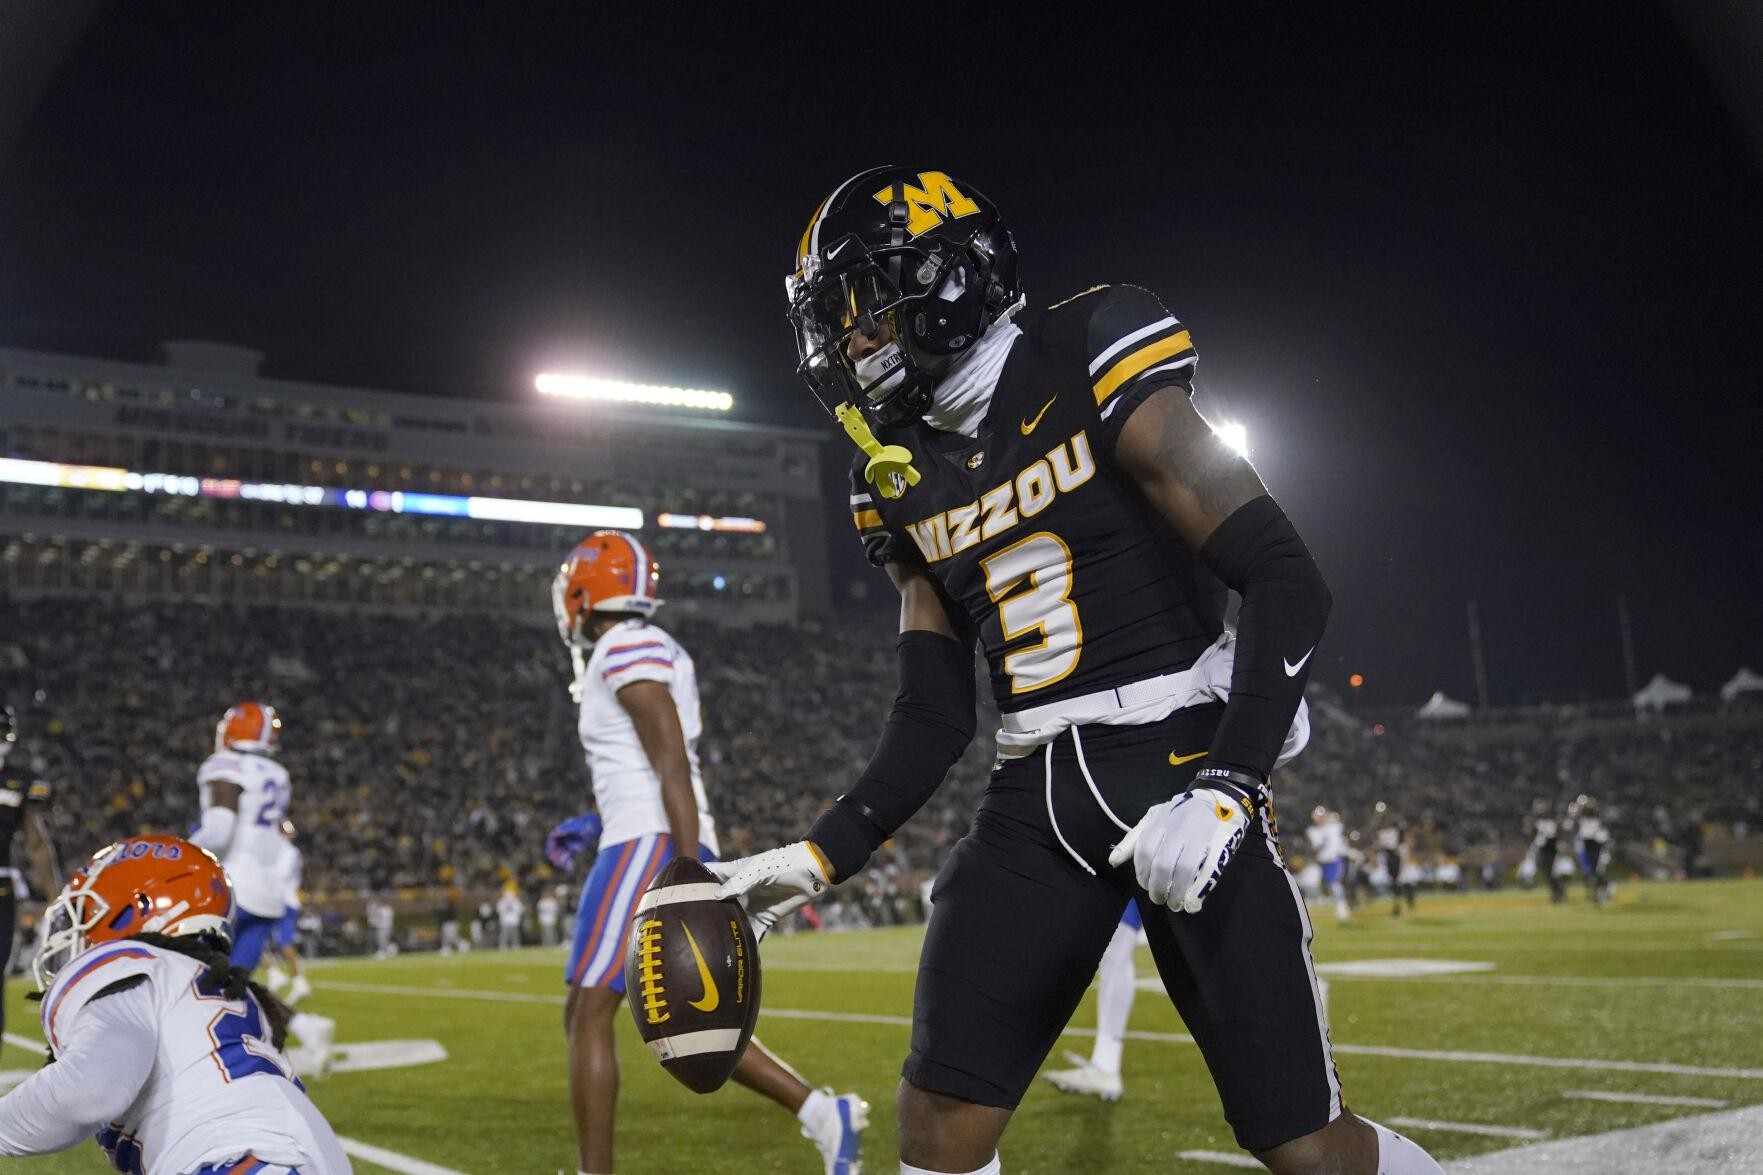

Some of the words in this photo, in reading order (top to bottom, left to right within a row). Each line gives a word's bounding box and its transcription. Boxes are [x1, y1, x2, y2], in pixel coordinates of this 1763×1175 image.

[872, 171, 981, 238] M
[904, 429, 1097, 563] MIZZOU
[978, 531, 1083, 694] 3
[80, 840, 182, 874] tors
[730, 920, 743, 957] ELITE
